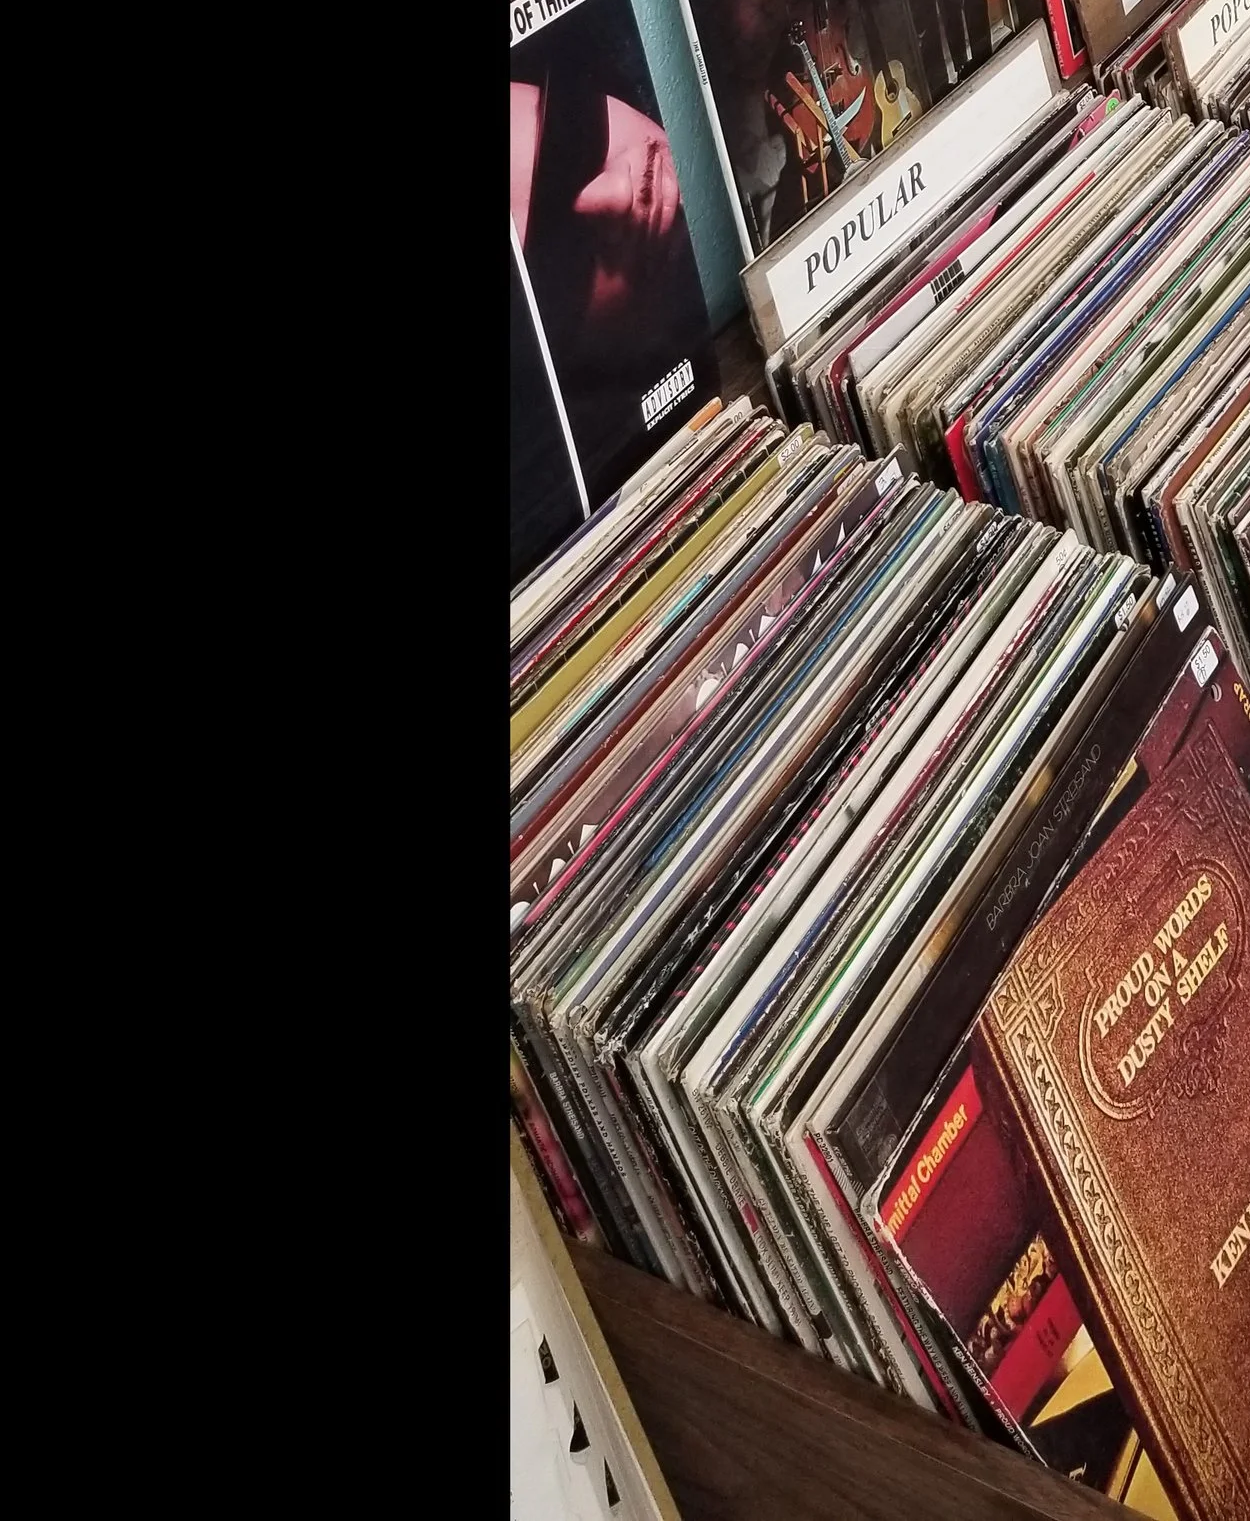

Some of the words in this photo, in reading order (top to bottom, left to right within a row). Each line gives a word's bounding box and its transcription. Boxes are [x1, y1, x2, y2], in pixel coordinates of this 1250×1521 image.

[513, 1, 535, 35] OF
[803, 160, 928, 295] POPULAR
[644, 364, 692, 420] ADVISORY
[646, 401, 674, 432] EXPLICIT
[673, 383, 695, 408] LYRICS
[780, 439, 801, 462] $2.00
[1117, 596, 1134, 621] $1.50
[985, 867, 1028, 935] BARBRA
[1026, 823, 1057, 873] JOAN
[1053, 741, 1102, 825] STREISAND
[1092, 950, 1155, 1040] PROUD
[1152, 872, 1214, 953] WORDS
[1143, 968, 1173, 1011] ON
[1170, 946, 1189, 975] A
[1116, 998, 1177, 1089] DUSTY
[1175, 920, 1231, 1008] SHELF
[547, 1071, 568, 1101] BARBRA
[560, 1100, 587, 1140] STREISAND
[578, 1081, 600, 1116] POLKAS
[595, 1118, 609, 1138] AND
[812, 1131, 824, 1144] PC
[916, 1101, 970, 1184] Chamber
[711, 1141, 735, 1176] DEBBIE
[774, 1279, 792, 1302] KEEP
[800, 1172, 811, 1187] BY
[807, 1187, 820, 1206] THE
[816, 1206, 831, 1229] TIME
[830, 1234, 843, 1254] GET
[839, 1254, 850, 1267] TO
[852, 1206, 874, 1237] BARBRA
[867, 1235, 895, 1276] STREISAND
[894, 1285, 920, 1325] FEATURING
[922, 1337, 936, 1355] WAY
[937, 1365, 952, 1385] WERE
[950, 1344, 967, 1364] KEN
[962, 1361, 991, 1398] HENSLEY
[993, 1406, 1016, 1435] PROUD
